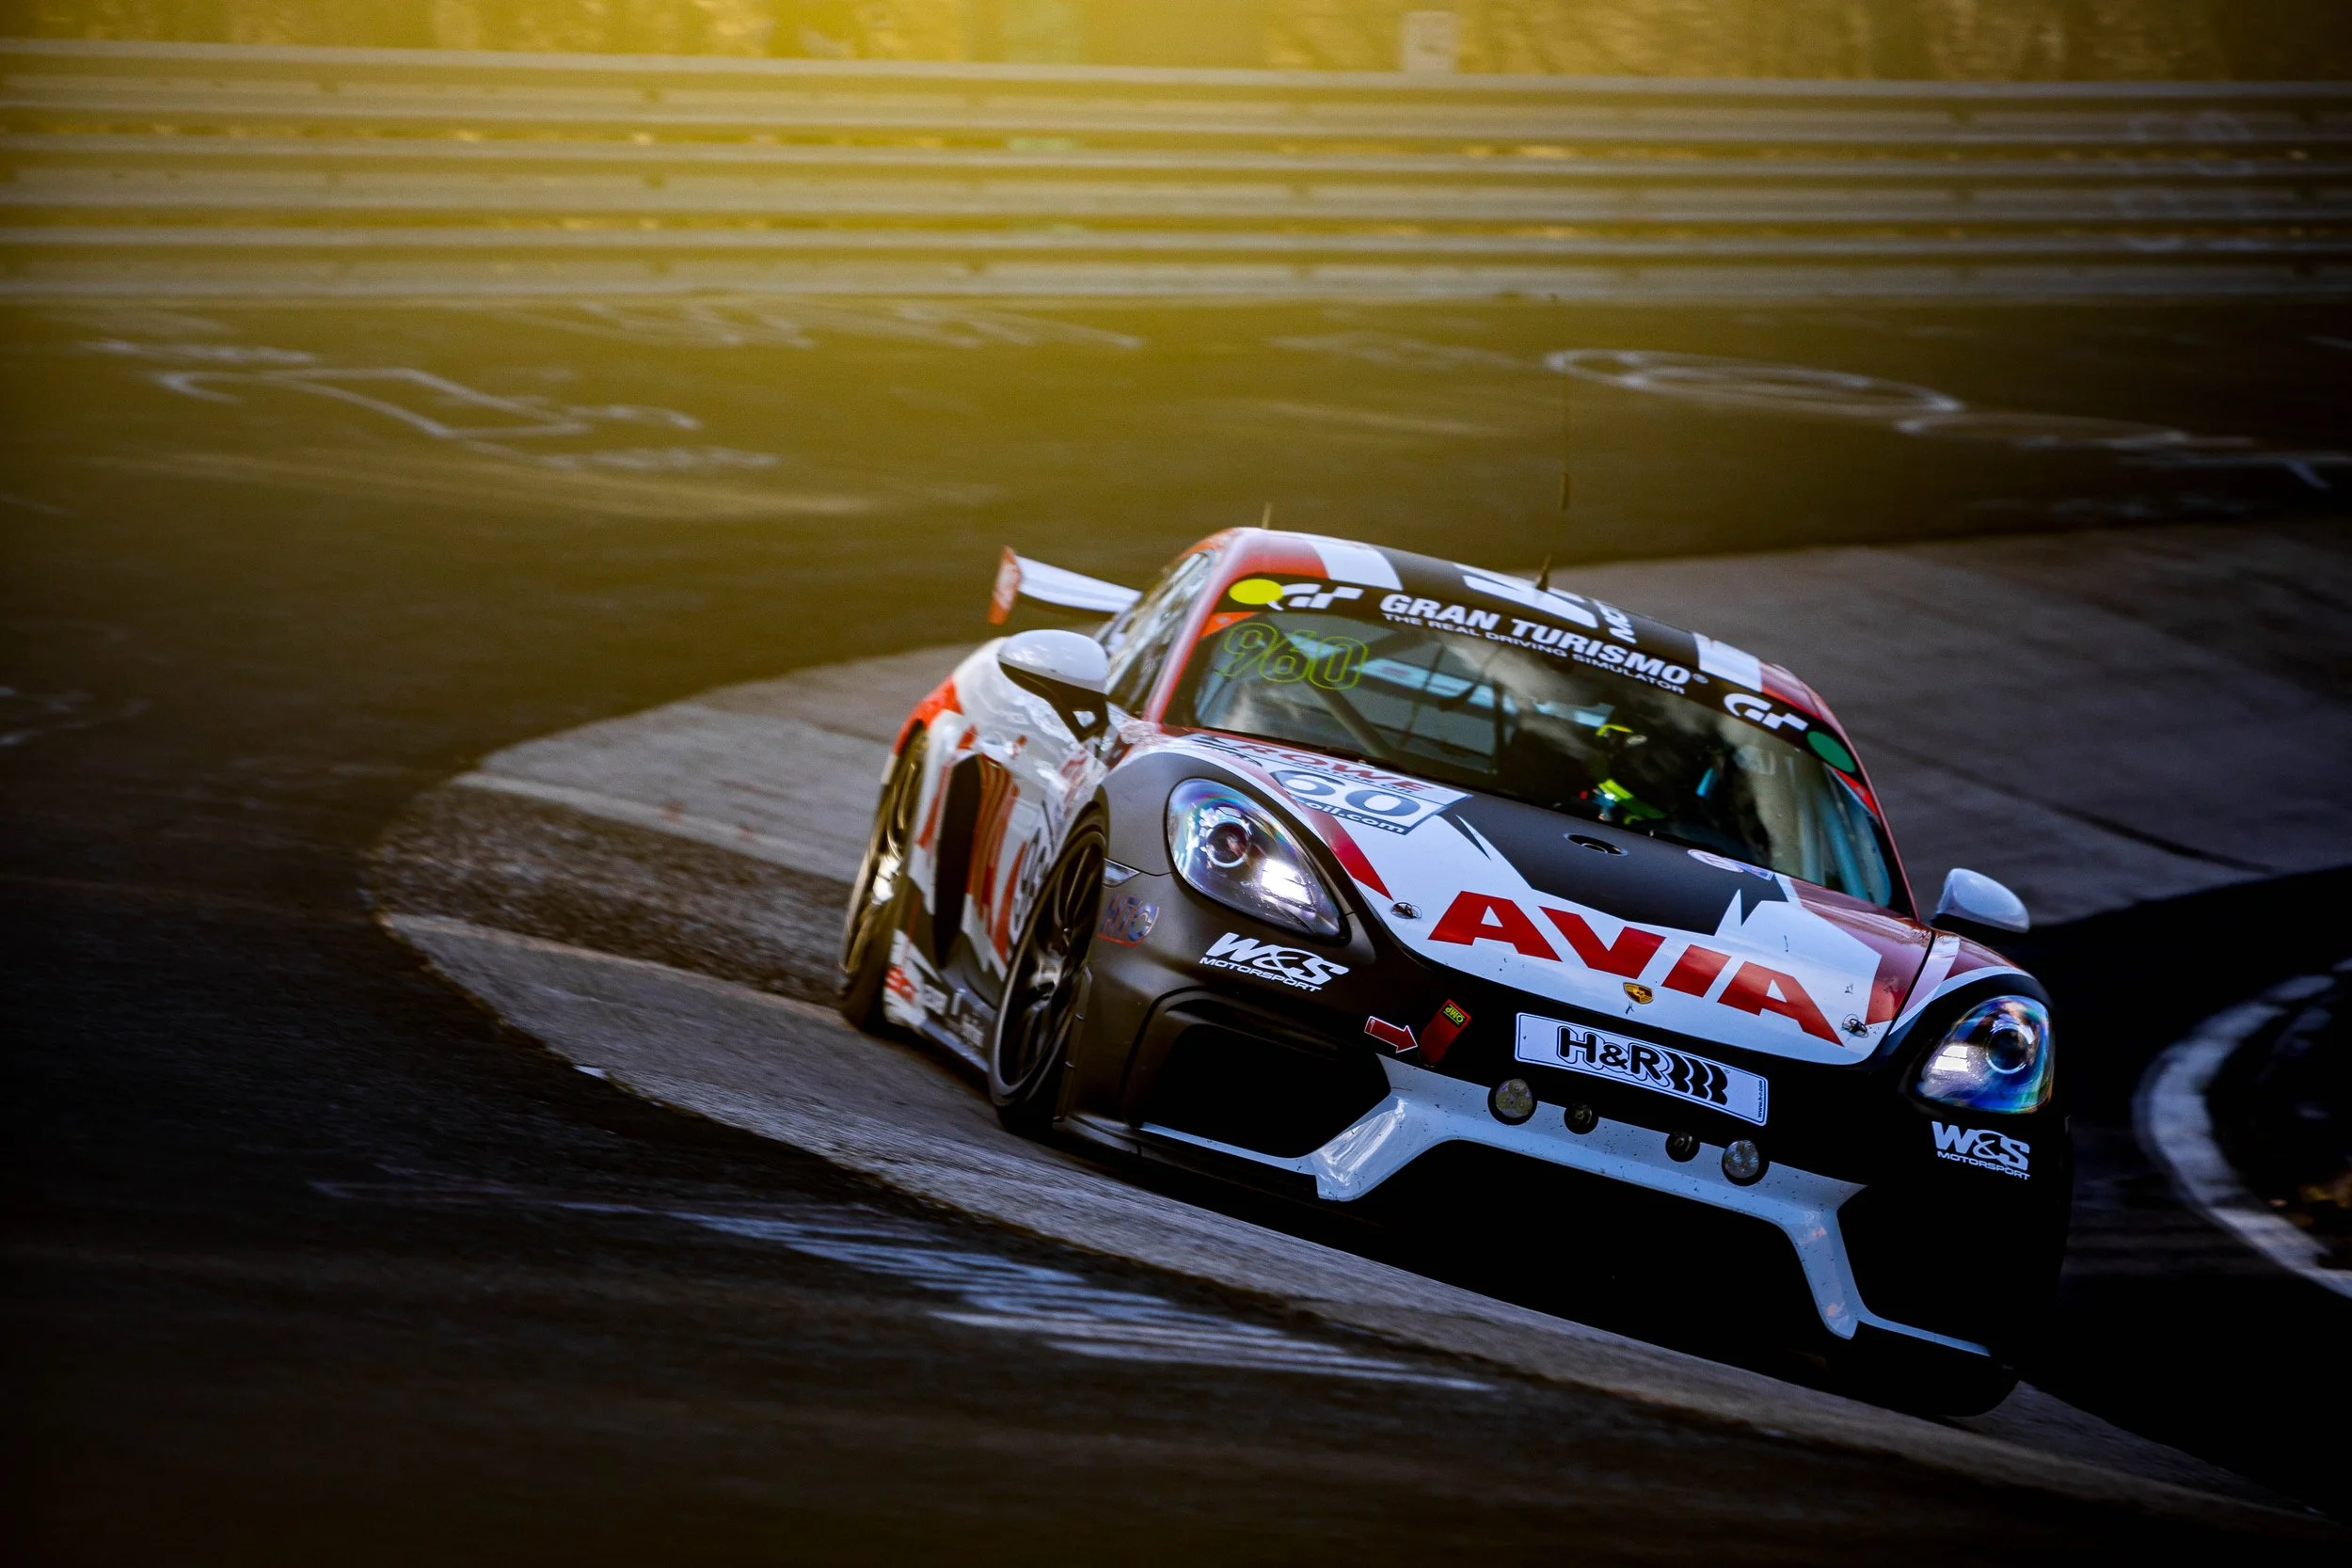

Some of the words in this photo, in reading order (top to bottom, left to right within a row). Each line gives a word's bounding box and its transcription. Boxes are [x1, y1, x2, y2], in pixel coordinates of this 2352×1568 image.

[1379, 594, 1502, 631] GRAN
[1215, 622, 1370, 690] 960
[1382, 612, 1423, 626] THE
[1427, 620, 1483, 637] REAL
[1485, 631, 1568, 657] DRIVING
[1572, 653, 1686, 695] SIMULATOR
[1234, 744, 1434, 792] ROWE
[1199, 957, 1322, 992] MOTORSPORT
[1205, 932, 1349, 985] W&S
[1428, 890, 1845, 1047] AVIA
[1444, 1006, 1464, 1023] OMP
[1558, 1026, 1663, 1082] H&R
[1931, 1120, 2030, 1171] W&S
[1937, 1150, 2030, 1180] MOTORSPORT
